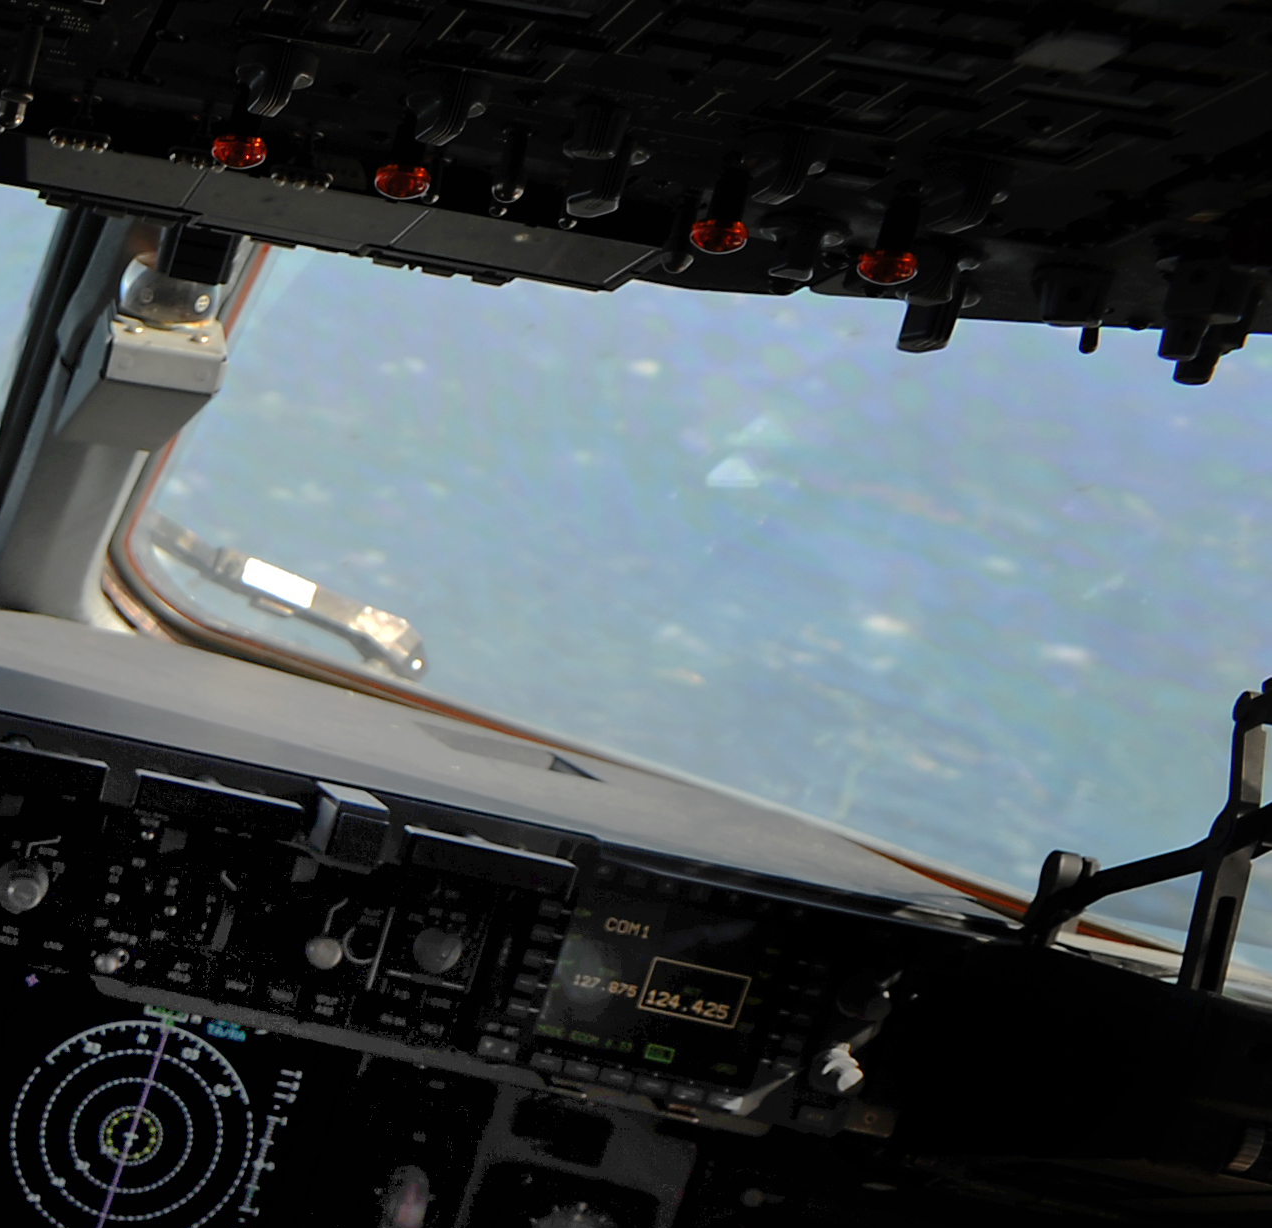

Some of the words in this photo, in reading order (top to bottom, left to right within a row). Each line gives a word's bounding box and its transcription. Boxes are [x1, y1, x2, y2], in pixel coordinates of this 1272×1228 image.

[604, 916, 651, 940] COM1
[572, 973, 639, 998] 127.875
[645, 988, 731, 1020] 124.425
